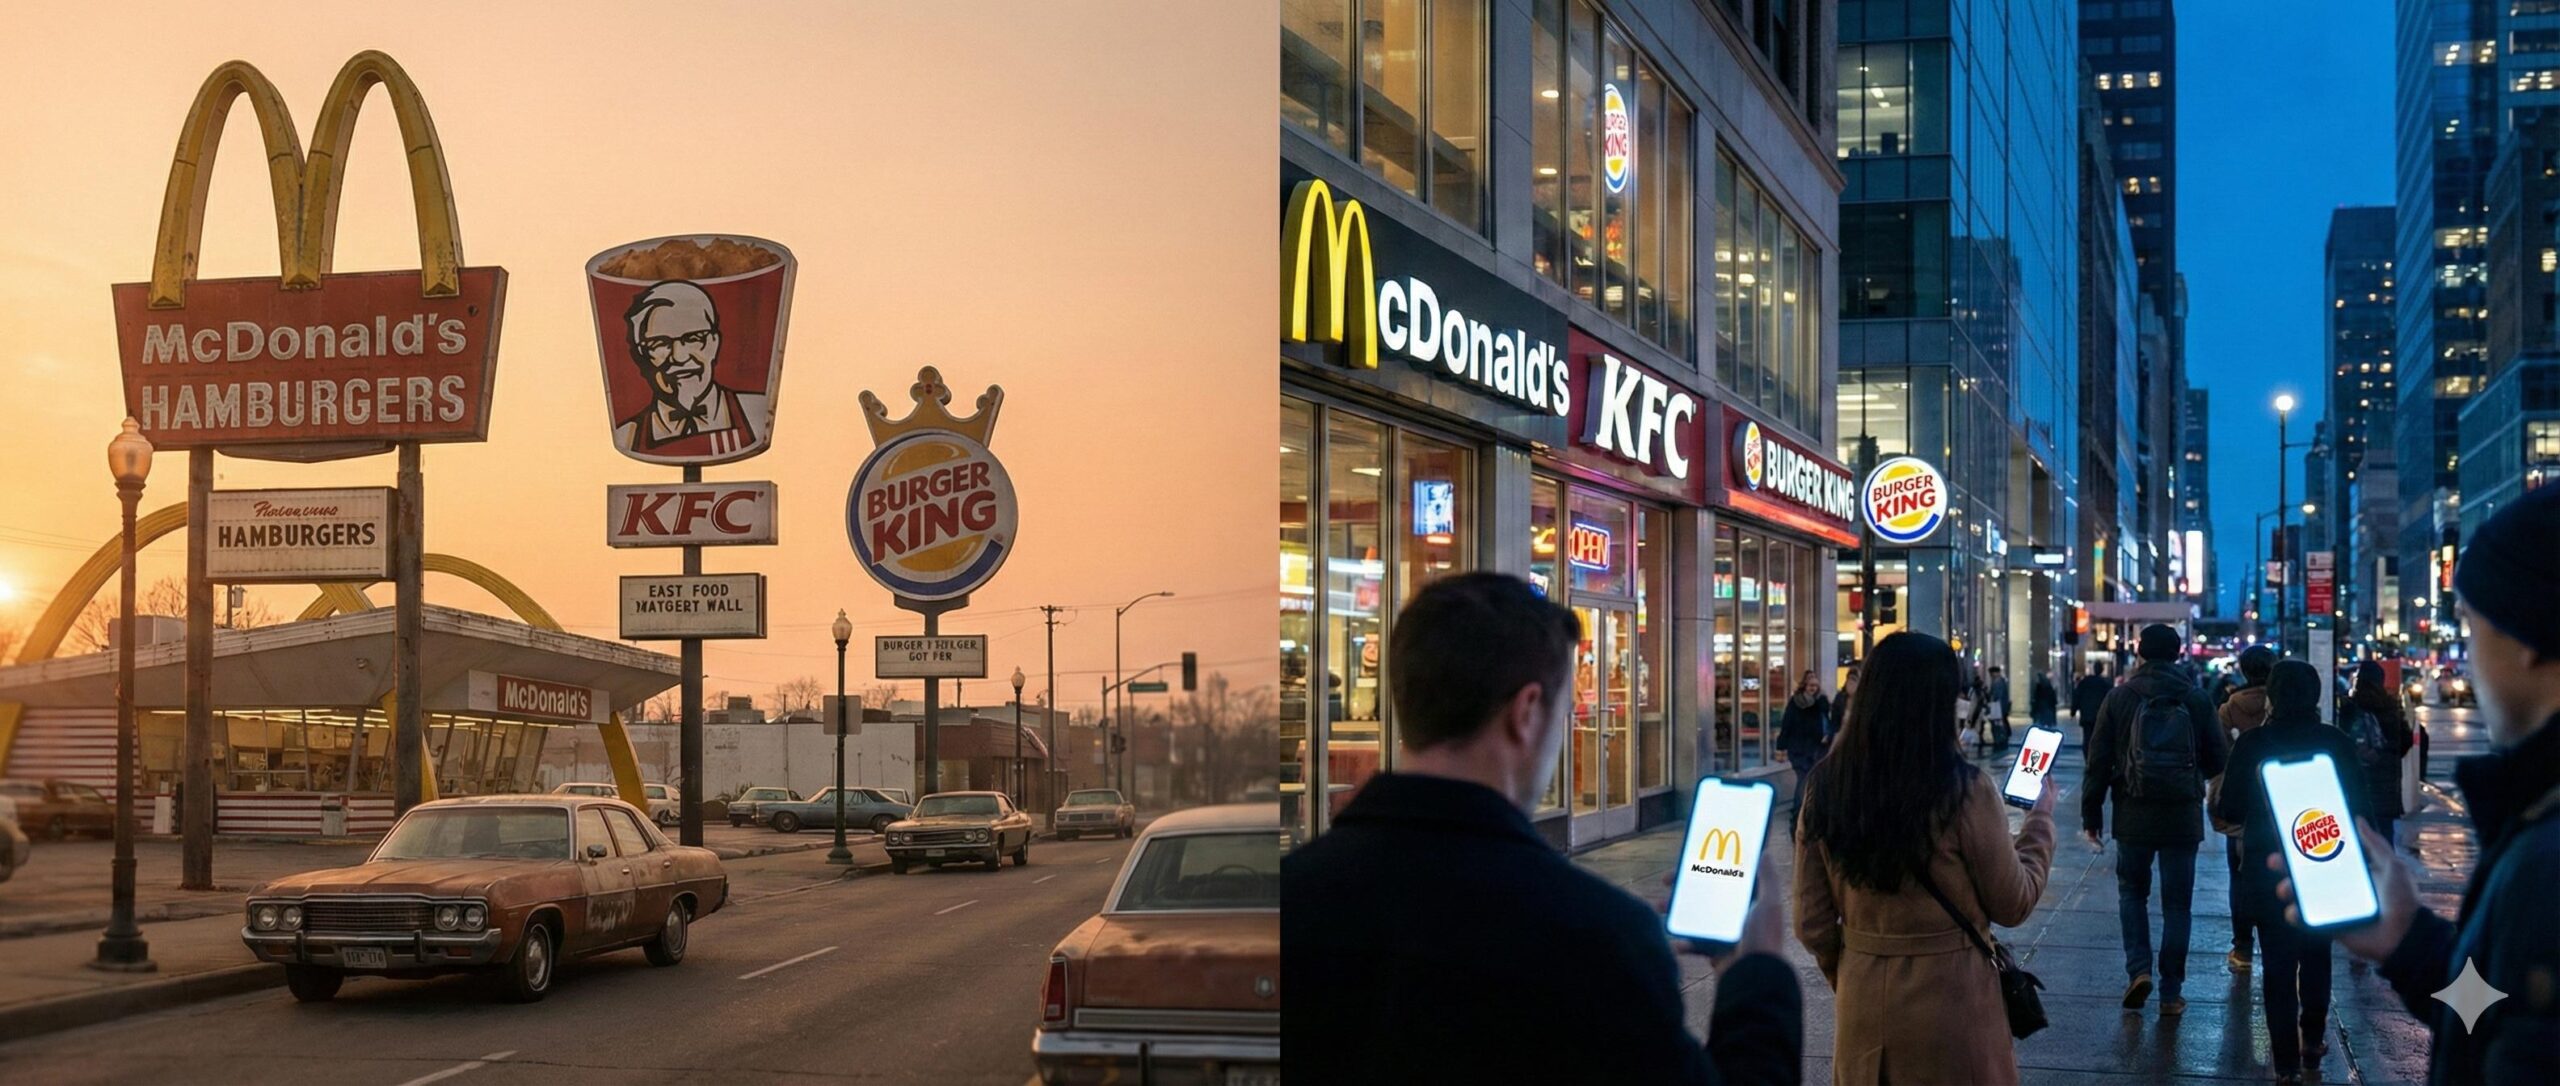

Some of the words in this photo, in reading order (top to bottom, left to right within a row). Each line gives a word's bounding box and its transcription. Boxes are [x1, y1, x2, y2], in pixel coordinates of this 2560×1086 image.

[141, 313, 467, 366] McDonald's
[141, 375, 466, 431] HAMBURGERS
[1595, 353, 1697, 480] KFC
[867, 461, 990, 522] BURGER
[1766, 440, 1822, 507] BURGER
[1824, 470, 1854, 521] KING
[1873, 474, 1934, 502] BURGER
[617, 490, 765, 536] KFC
[1875, 488, 1937, 522] KING
[218, 522, 376, 548] HAMBURGERS
[872, 490, 996, 563] KING
[1570, 526, 1609, 566] OPEN
[649, 584, 683, 597] EAST
[692, 584, 729, 597] FOOD
[707, 600, 743, 612] WALL
[883, 640, 923, 651] BURGER
[909, 652, 928, 661] GOT
[505, 680, 588, 717] McDonald's
[2296, 814, 2336, 840] BURGER
[2301, 823, 2340, 854] KING
